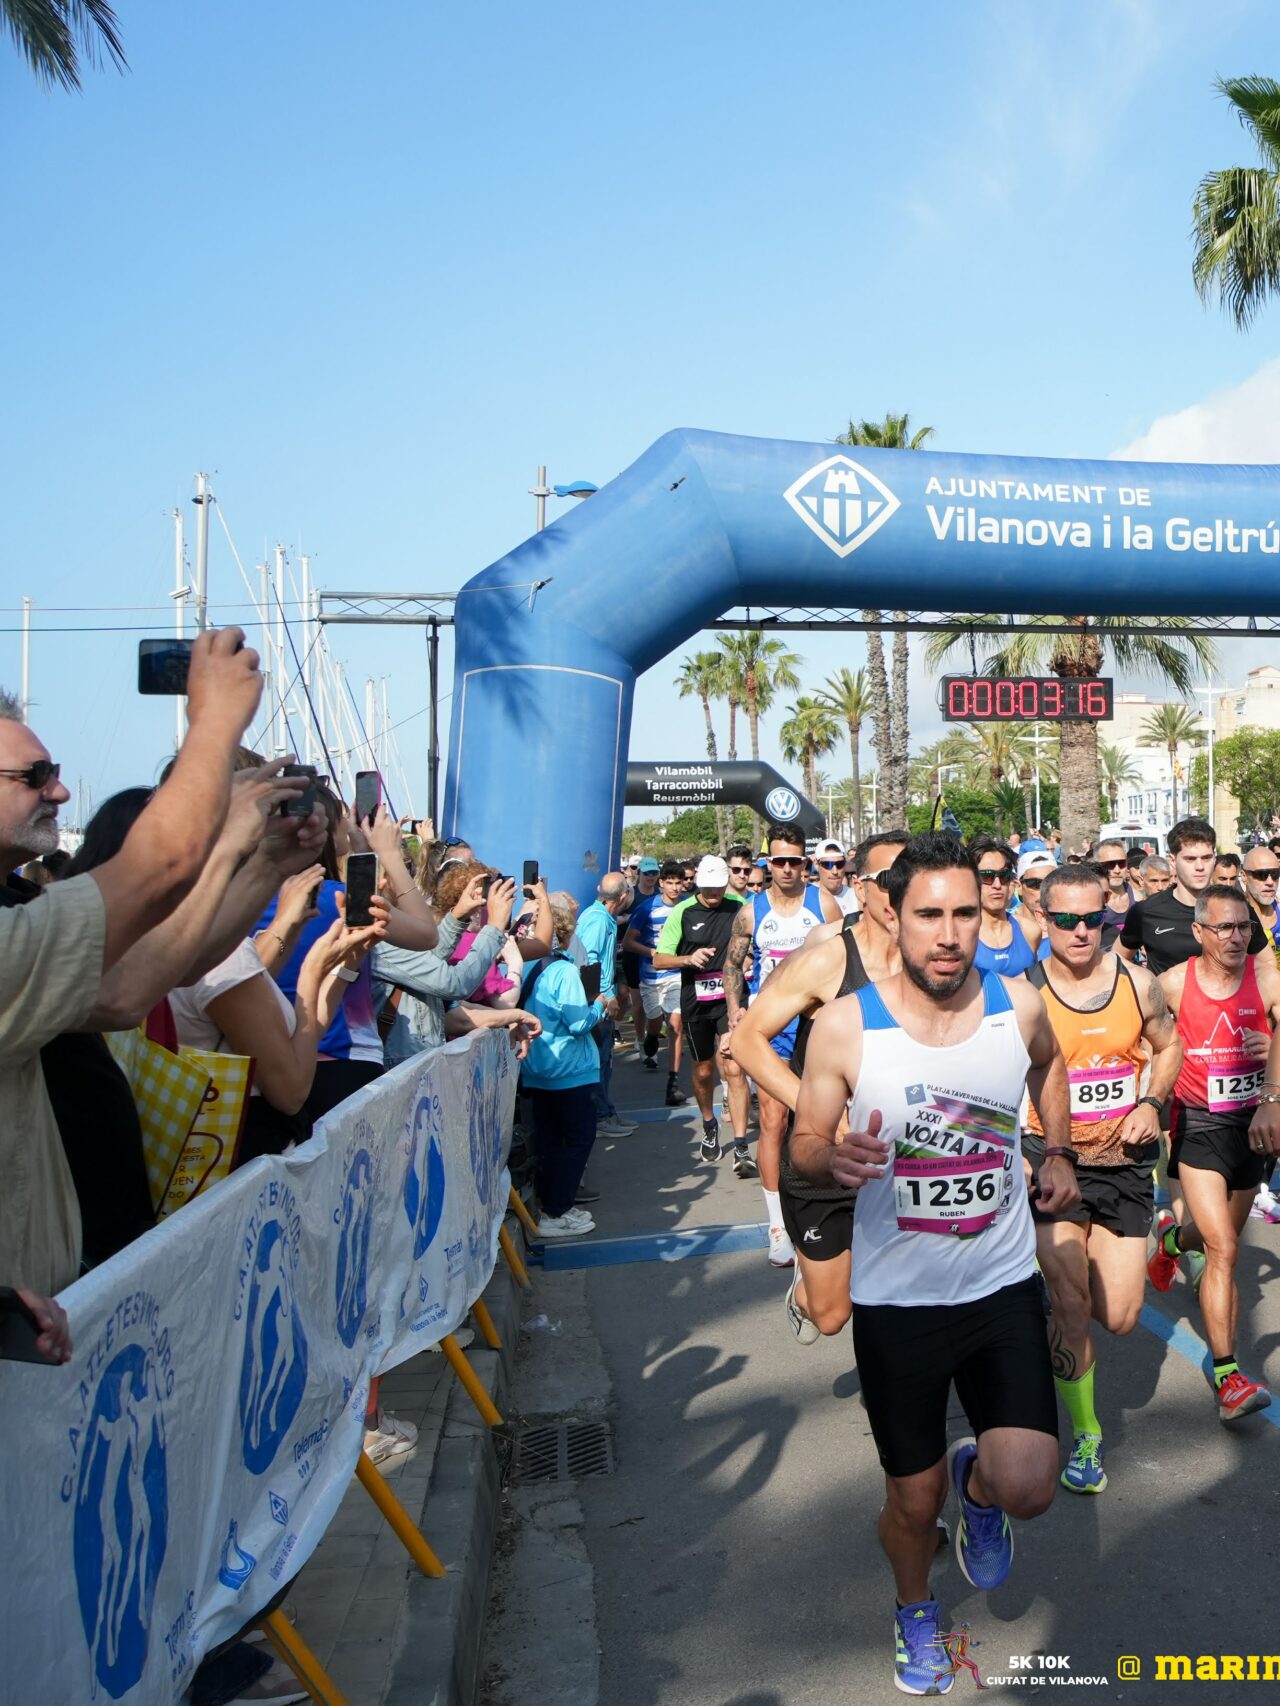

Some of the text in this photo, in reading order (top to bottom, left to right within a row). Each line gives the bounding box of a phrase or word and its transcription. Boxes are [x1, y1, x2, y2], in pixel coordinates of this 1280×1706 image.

[925, 476, 1152, 507] AJUNTAMENT DE
[925, 504, 1280, 554] Vilanova i la Geltrú
[654, 766, 713, 776] Vilamòbil
[645, 778, 724, 790] Tarracomòbil
[652, 793, 716, 802] Reusmòbil
[926, 1084, 950, 1095] PLATJA
[951, 1091, 982, 1103] TAVERNES
[1078, 1080, 1124, 1104] 895
[1215, 1071, 1266, 1095] 1235
[916, 1110, 942, 1125] XXXI
[905, 1122, 965, 1156] VOLTA
[907, 1173, 996, 1207] 1236
